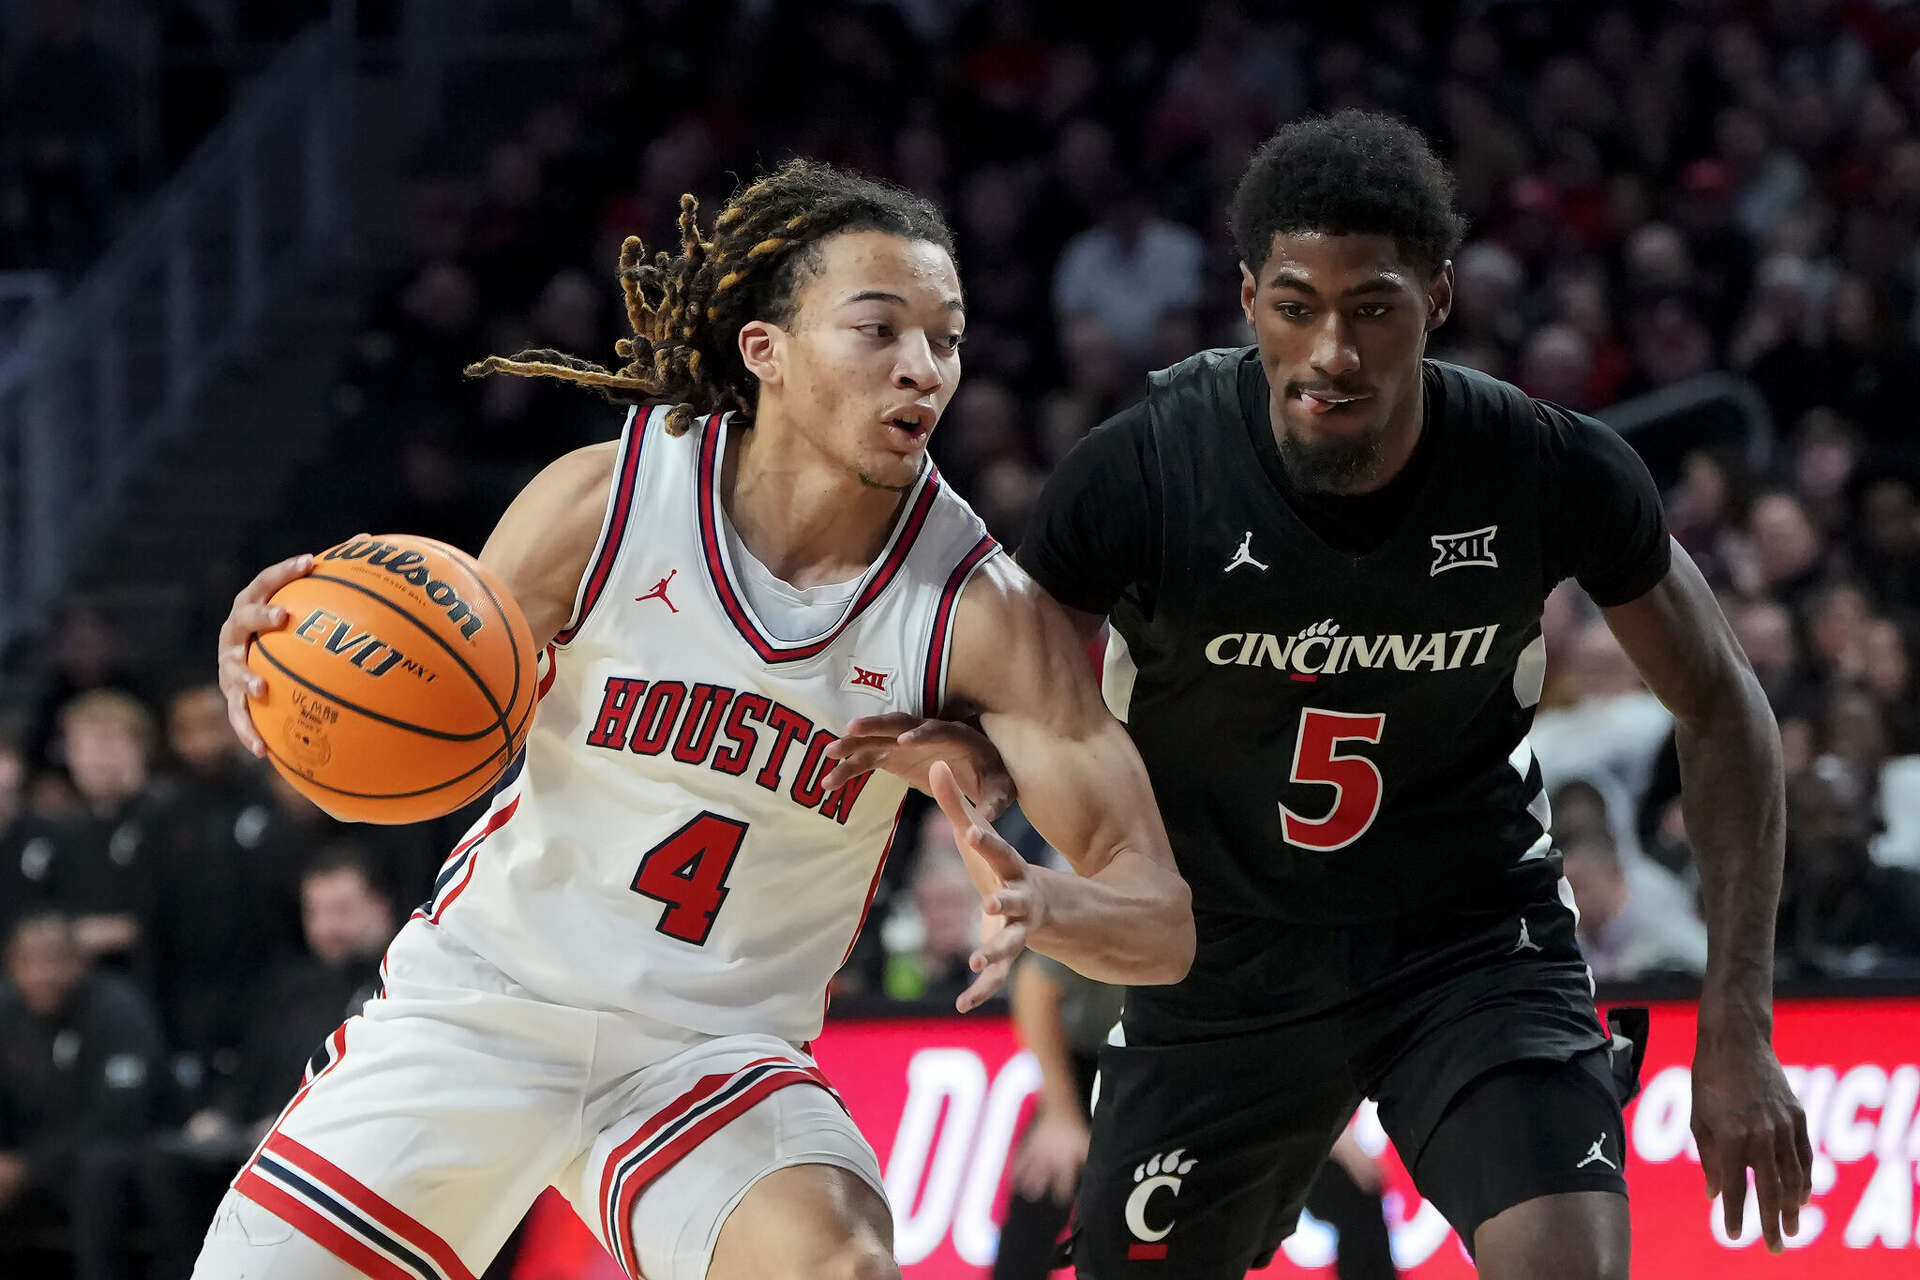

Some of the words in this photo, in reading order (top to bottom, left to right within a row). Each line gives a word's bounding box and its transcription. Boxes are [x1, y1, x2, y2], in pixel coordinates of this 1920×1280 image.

[324, 541, 483, 641] Wilson
[295, 608, 404, 677] EVO
[402, 659, 437, 682] NXT
[1205, 623, 1500, 674] CINCINNATI
[1278, 706, 1386, 852] 5
[630, 810, 750, 947] 4
[1125, 1175, 1182, 1242] C
